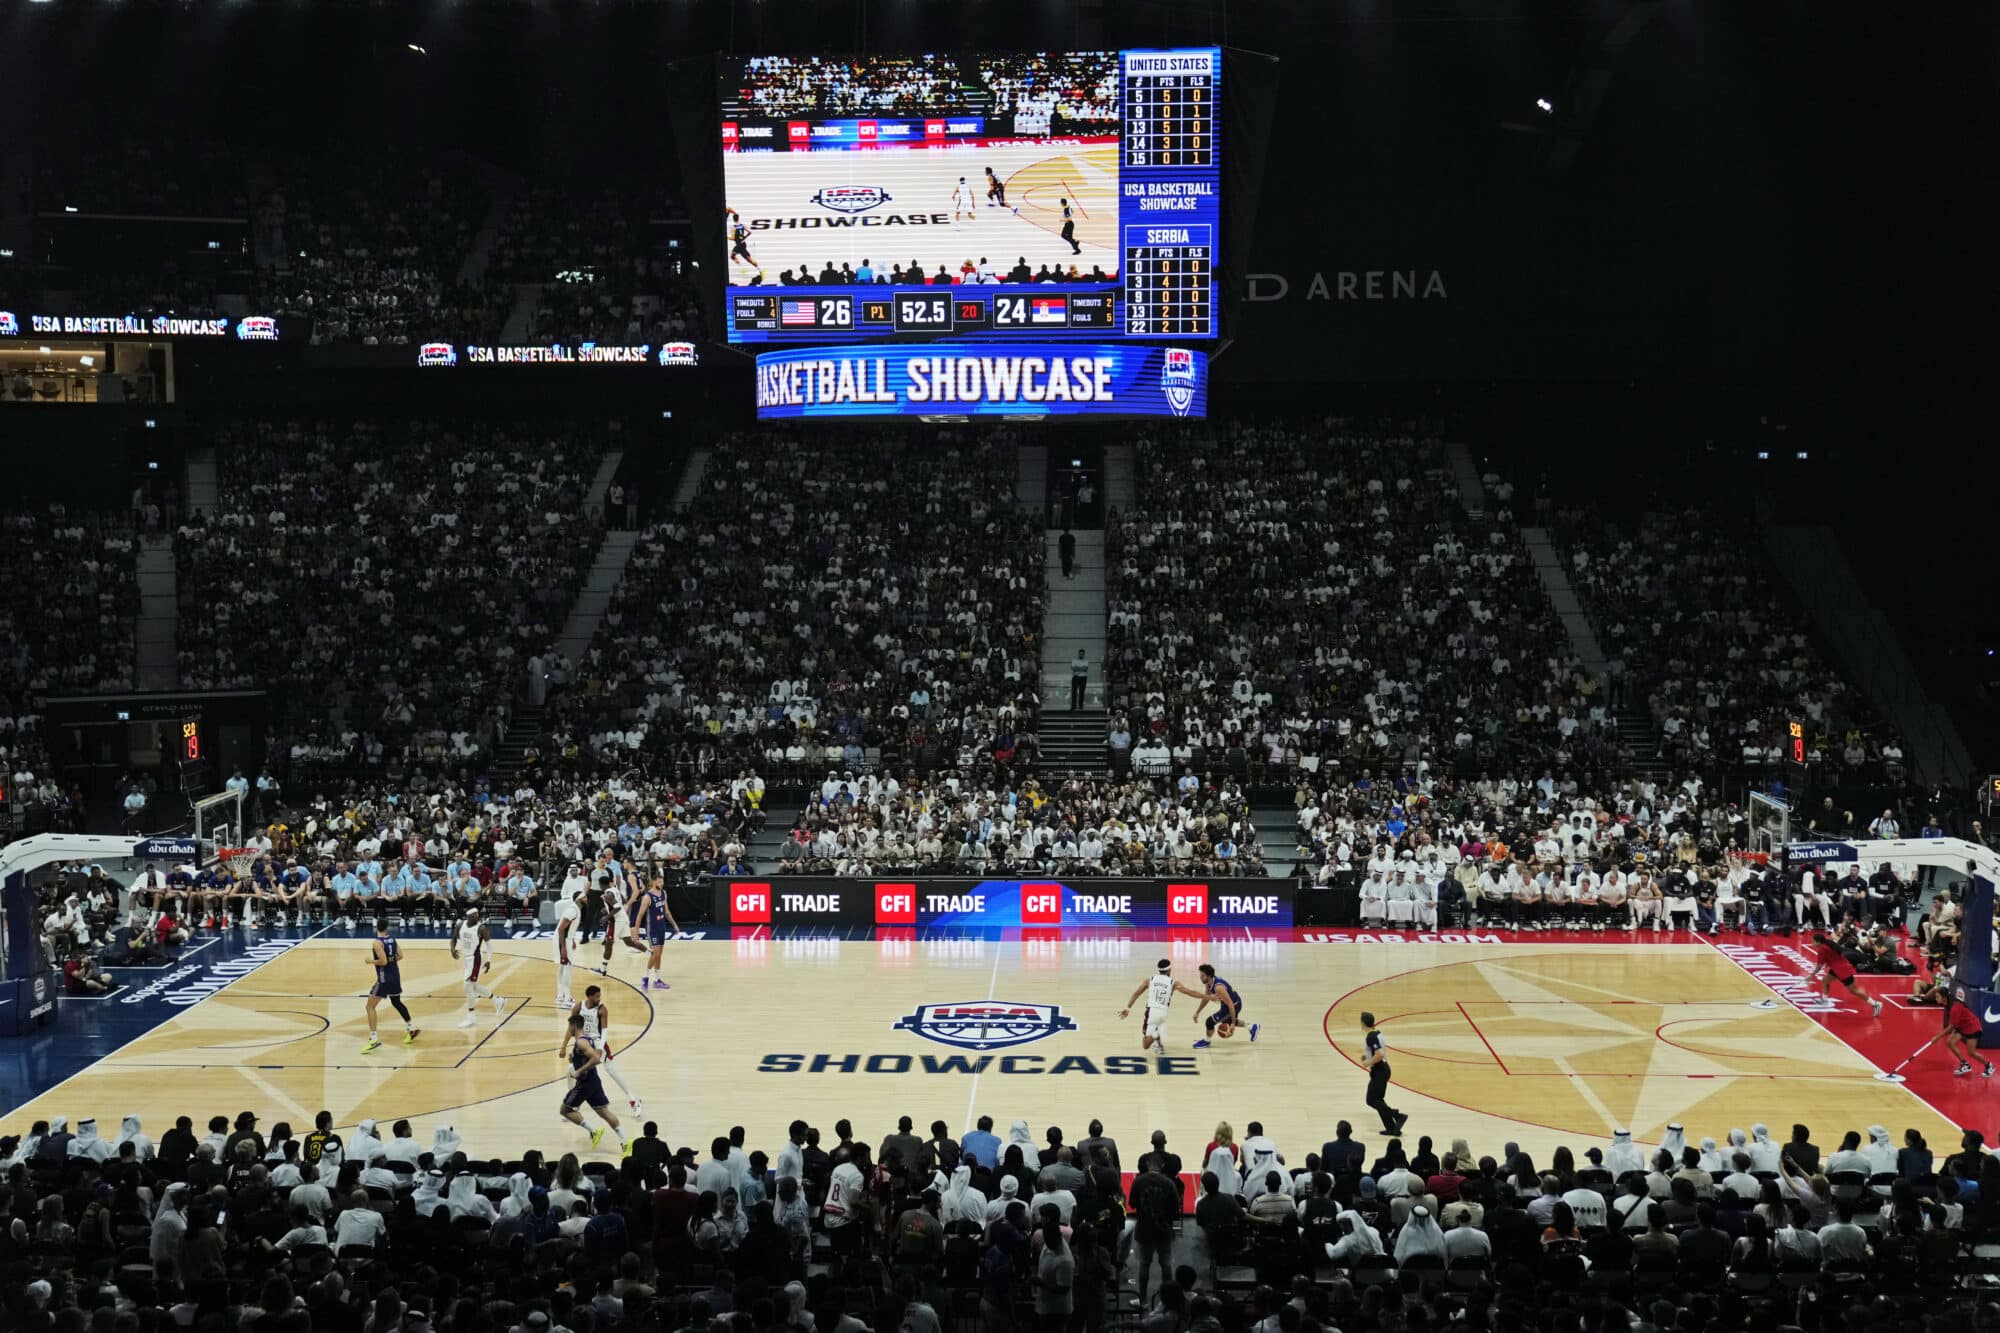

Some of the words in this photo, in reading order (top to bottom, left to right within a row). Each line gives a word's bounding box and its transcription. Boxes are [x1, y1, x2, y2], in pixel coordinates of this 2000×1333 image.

[1130, 58, 1167, 71] UNITED
[1170, 58, 1209, 70] STATES
[1160, 77, 1174, 86] PTS
[1190, 77, 1204, 86] FLS
[1135, 90, 1143, 102] 5
[1163, 90, 1170, 102] 5
[1193, 90, 1200, 102] 0
[1135, 106, 1143, 118] 9
[1163, 106, 1170, 118] 0
[1194, 105, 1200, 118] 1
[1132, 121, 1146, 134] 13
[1163, 121, 1170, 133] 5
[1193, 120, 1200, 133] 0
[1132, 136, 1146, 149] 14
[1163, 136, 1170, 149] 3
[1193, 136, 1200, 148] 0
[1132, 152, 1146, 164] 15
[1163, 152, 1170, 164] 0
[1194, 152, 1200, 164] 1
[1125, 184, 1145, 196] USA
[1148, 183, 1213, 196] BASKETBALL
[1140, 198, 1197, 210] SHOWCASE
[750, 213, 952, 230] SHOWCASE
[1147, 229, 1190, 244] SERBIA
[1159, 248, 1174, 258] PTS
[1189, 248, 1202, 257] FLS
[1135, 261, 1142, 272] 0
[1162, 260, 1170, 272] 0
[1192, 260, 1199, 272] 0
[1135, 276, 1142, 288] 3
[1162, 276, 1170, 288] 4
[1192, 276, 1198, 287] 1
[1306, 270, 1448, 300] ARENA
[770, 298, 774, 306] 1
[1162, 291, 1170, 302] 0
[1192, 290, 1199, 302] 0
[1072, 299, 1102, 307] TIMEOUTS
[1106, 298, 1112, 308] 2
[736, 310, 755, 318] FOULS
[770, 310, 776, 318] 4
[822, 300, 850, 325] 26
[870, 306, 885, 318] P1
[902, 301, 945, 323] 52.5
[962, 304, 977, 318] 20
[997, 298, 1026, 323] 24
[1132, 306, 1145, 318] 13
[1162, 306, 1170, 318] 2
[1192, 306, 1198, 317] 1
[756, 320, 776, 328] BONUS
[1072, 314, 1092, 322] FOULS
[32, 316, 61, 333] USA
[65, 316, 149, 334] BASKETBALL
[152, 317, 226, 336] SHOWCASE
[1132, 321, 1146, 333] 22
[1162, 320, 1170, 332] 2
[1192, 320, 1198, 332] 1
[468, 346, 494, 362] USA
[497, 346, 574, 362] BASKETBALL
[578, 346, 647, 362] SHOWCASE
[906, 357, 1113, 402] SHOWCASE
[188, 736, 198, 758] 19
[148, 844, 167, 853] abu
[1788, 850, 1808, 860] abu
[1810, 848, 1840, 858] dhabi
[736, 895, 766, 912] CFI
[775, 894, 840, 913] .TRADE
[881, 895, 910, 912] CFI
[920, 895, 985, 913] .TRADE
[1026, 896, 1056, 912] CFI
[1066, 896, 1132, 913] .TRADE
[1173, 896, 1202, 914] CFI
[1212, 896, 1278, 914] .TRADE
[1302, 934, 1502, 944] USAB.COM
[160, 977, 239, 1005] abu
[209, 937, 305, 976] dhabi
[933, 1008, 1042, 1021] USA
[756, 1054, 1201, 1076] SHOWCASE
[310, 1142, 322, 1160] 8
[832, 1184, 840, 1201] 8
